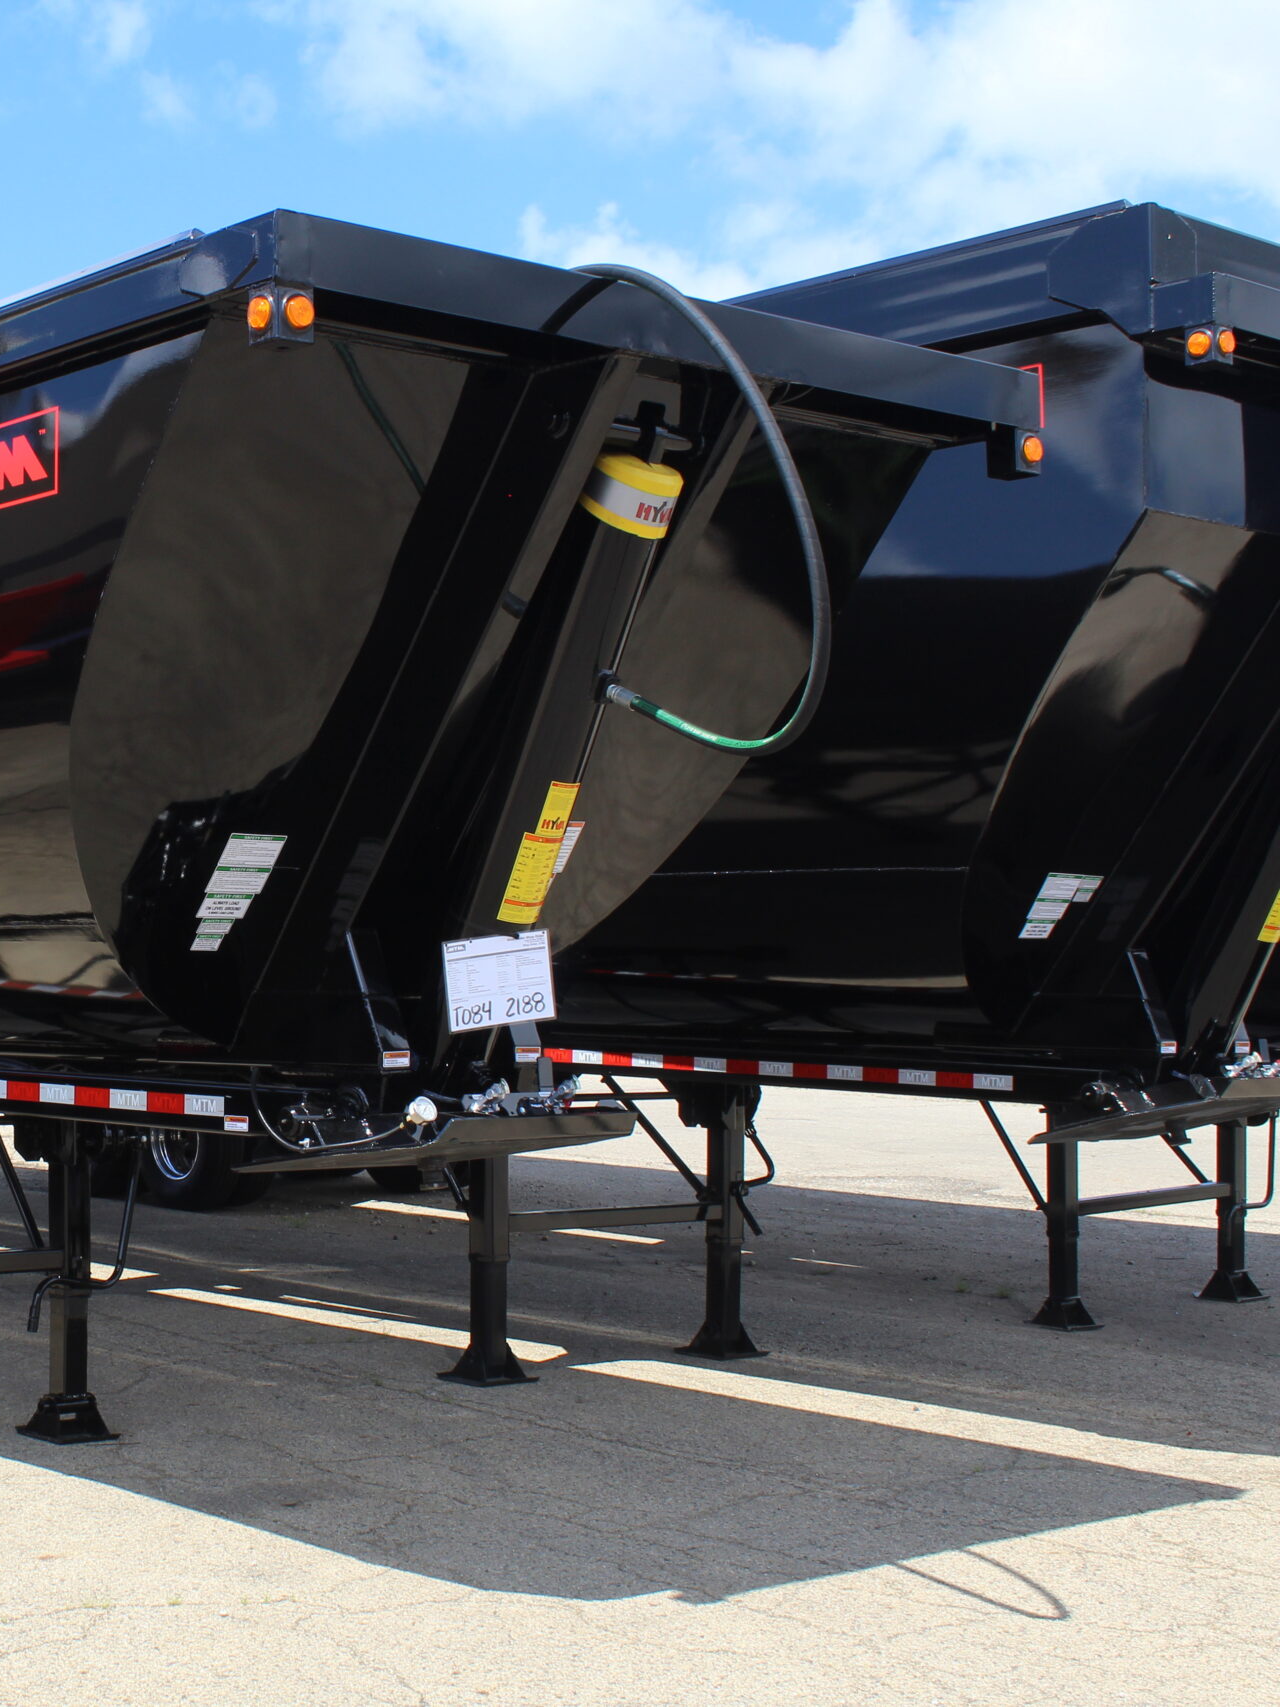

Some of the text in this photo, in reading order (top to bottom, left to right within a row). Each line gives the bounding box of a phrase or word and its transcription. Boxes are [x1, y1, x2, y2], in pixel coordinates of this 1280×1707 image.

[453, 992, 545, 1027] T084 2188
[906, 1071, 929, 1082] MTM
[981, 1076, 1005, 1088] MTM
[47, 1087, 67, 1101] MTM
[118, 1092, 140, 1107] MTM
[192, 1098, 217, 1113] MTM
